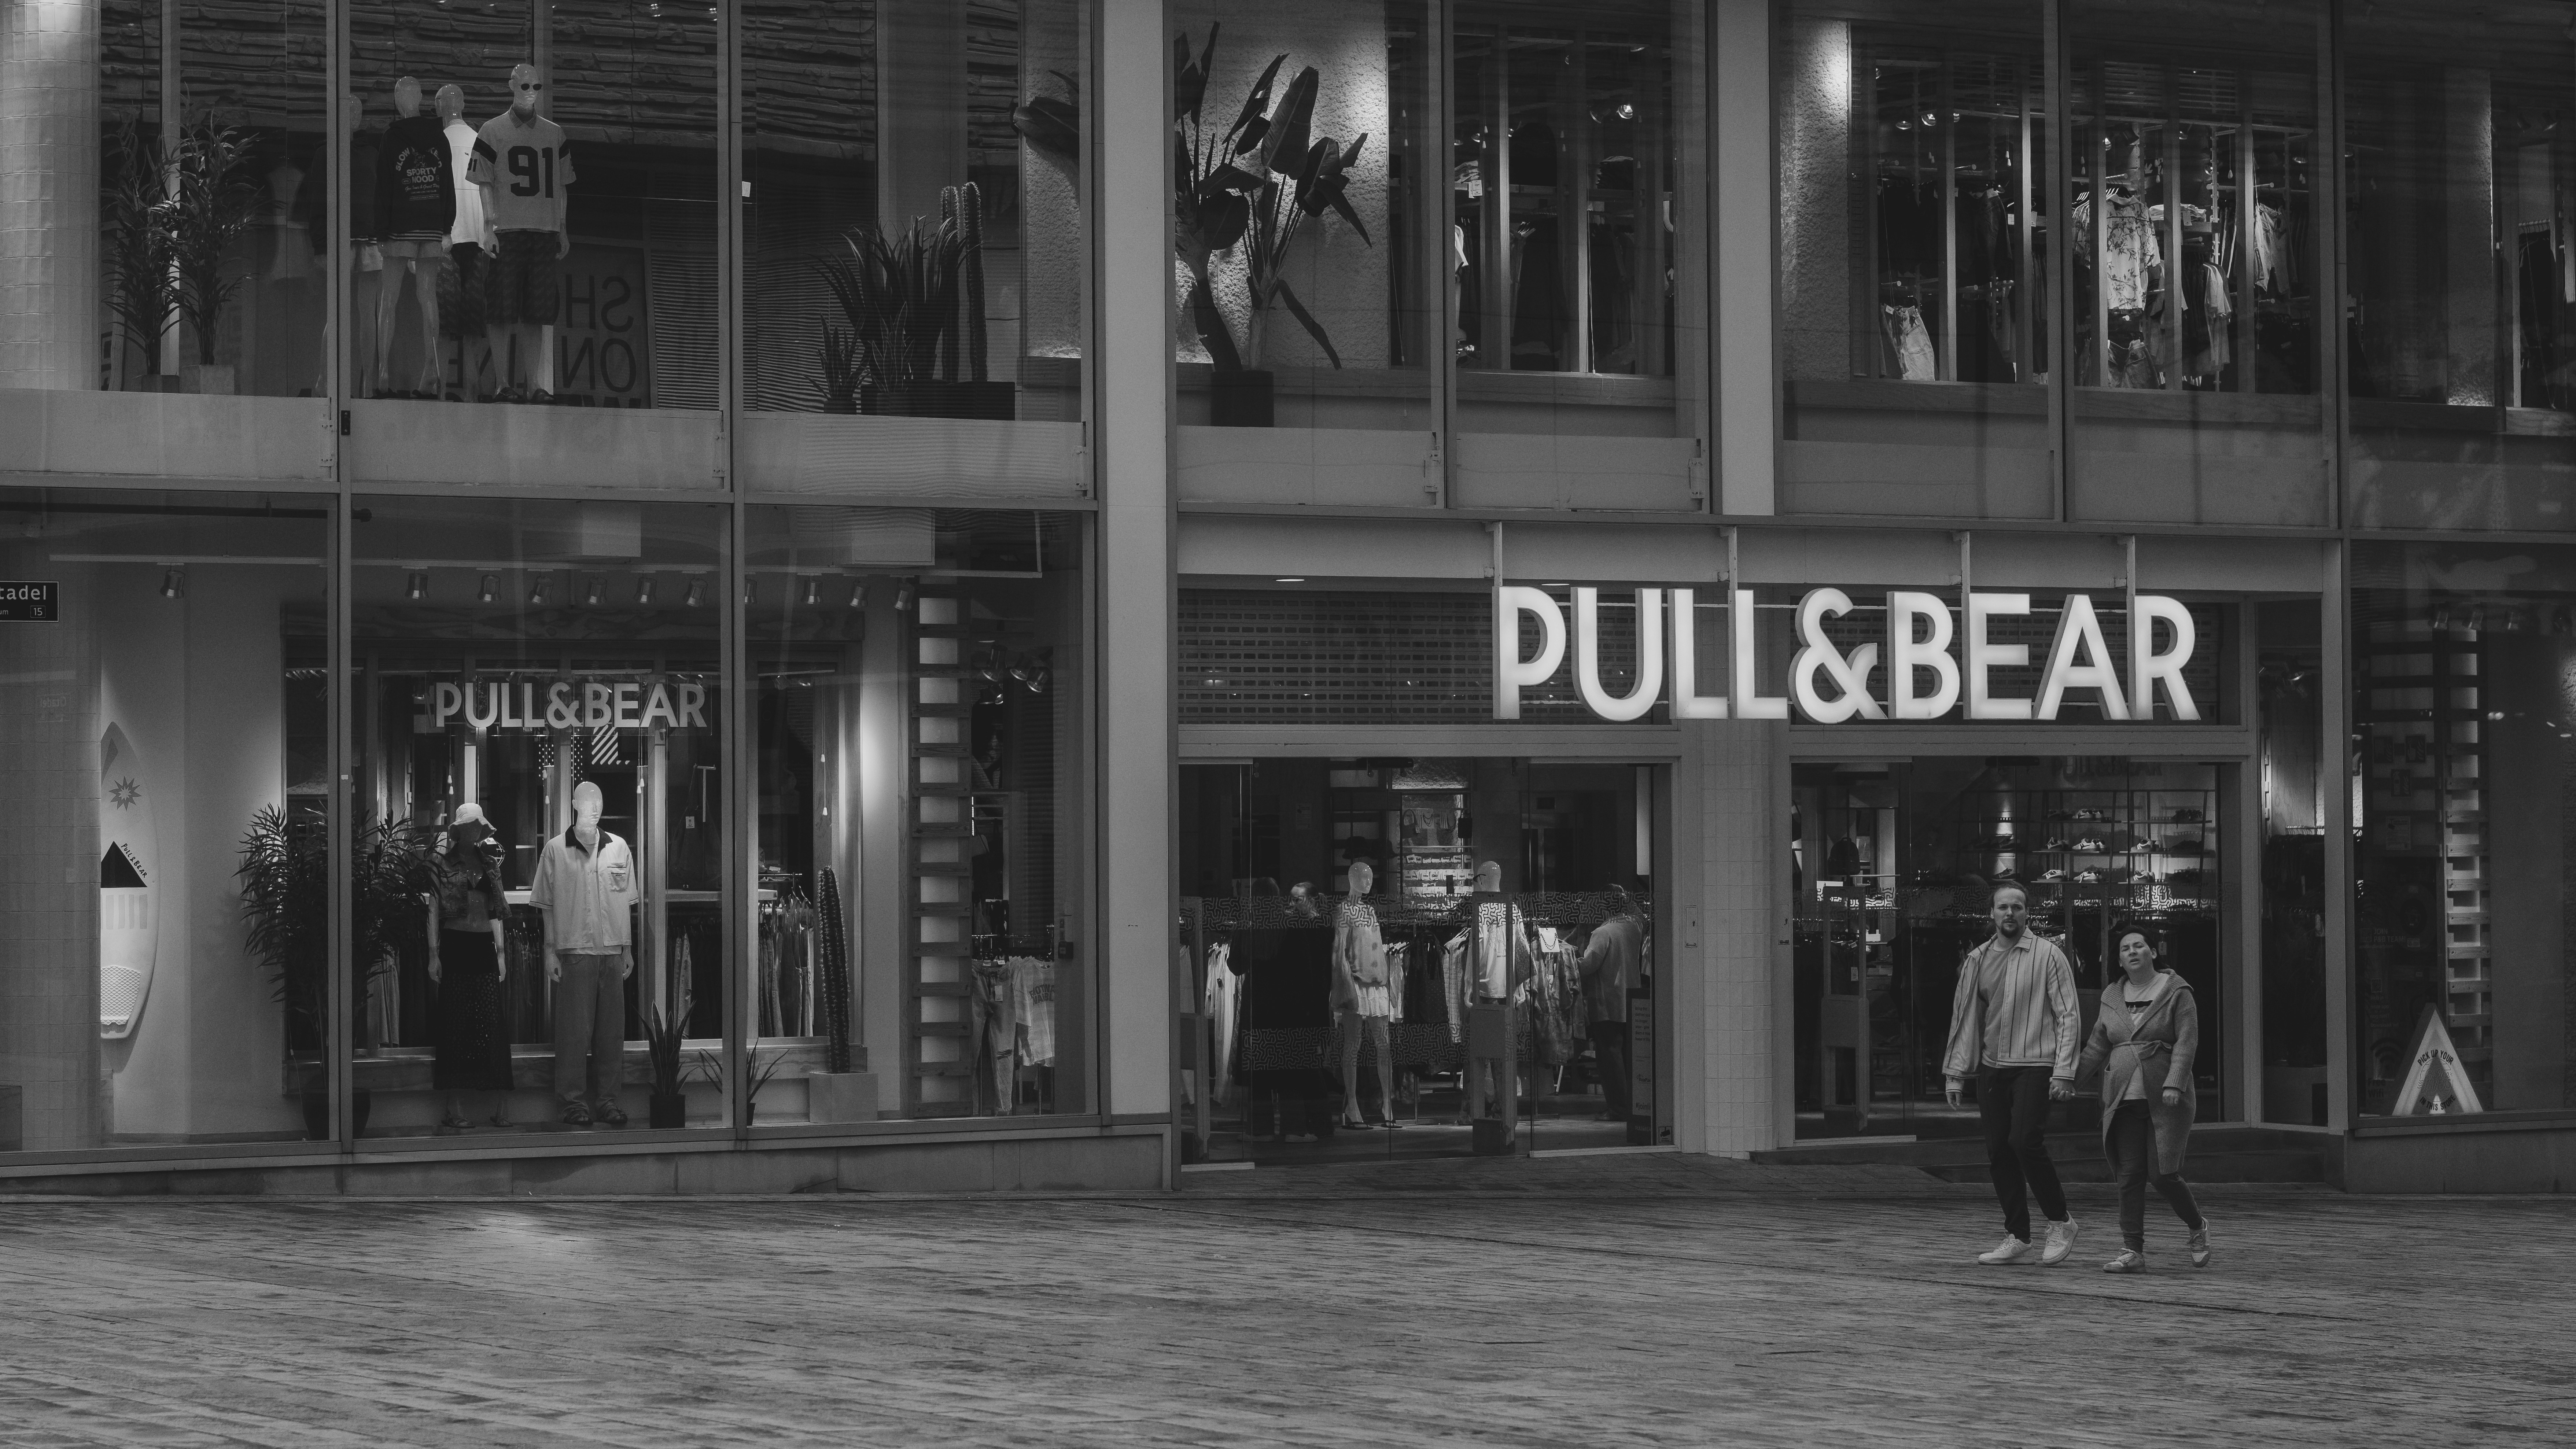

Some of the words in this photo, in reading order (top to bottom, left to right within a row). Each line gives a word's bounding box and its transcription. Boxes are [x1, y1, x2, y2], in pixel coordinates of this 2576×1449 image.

[395, 147, 410, 172] SLOW
[406, 167, 437, 177] SPORTY
[412, 175, 434, 184] MOOD
[508, 145, 554, 199] 91
[33, 608, 43, 616] 15
[1492, 585, 2201, 724] PULL&BEAR
[435, 681, 708, 729] PULL&BEAR
[121, 843, 148, 878] PULL&BEAR
[2417, 1051, 2431, 1066] PICK
[2430, 1049, 2438, 1058] UP
[2440, 1050, 2454, 1065] YOUR
[2367, 1078, 2386, 1086] Free
[2367, 1088, 2384, 1098] Wifi
[2419, 1096, 2427, 1105] IN
[2426, 1101, 2438, 1111] THIS
[2440, 1094, 2456, 1110] STORE
